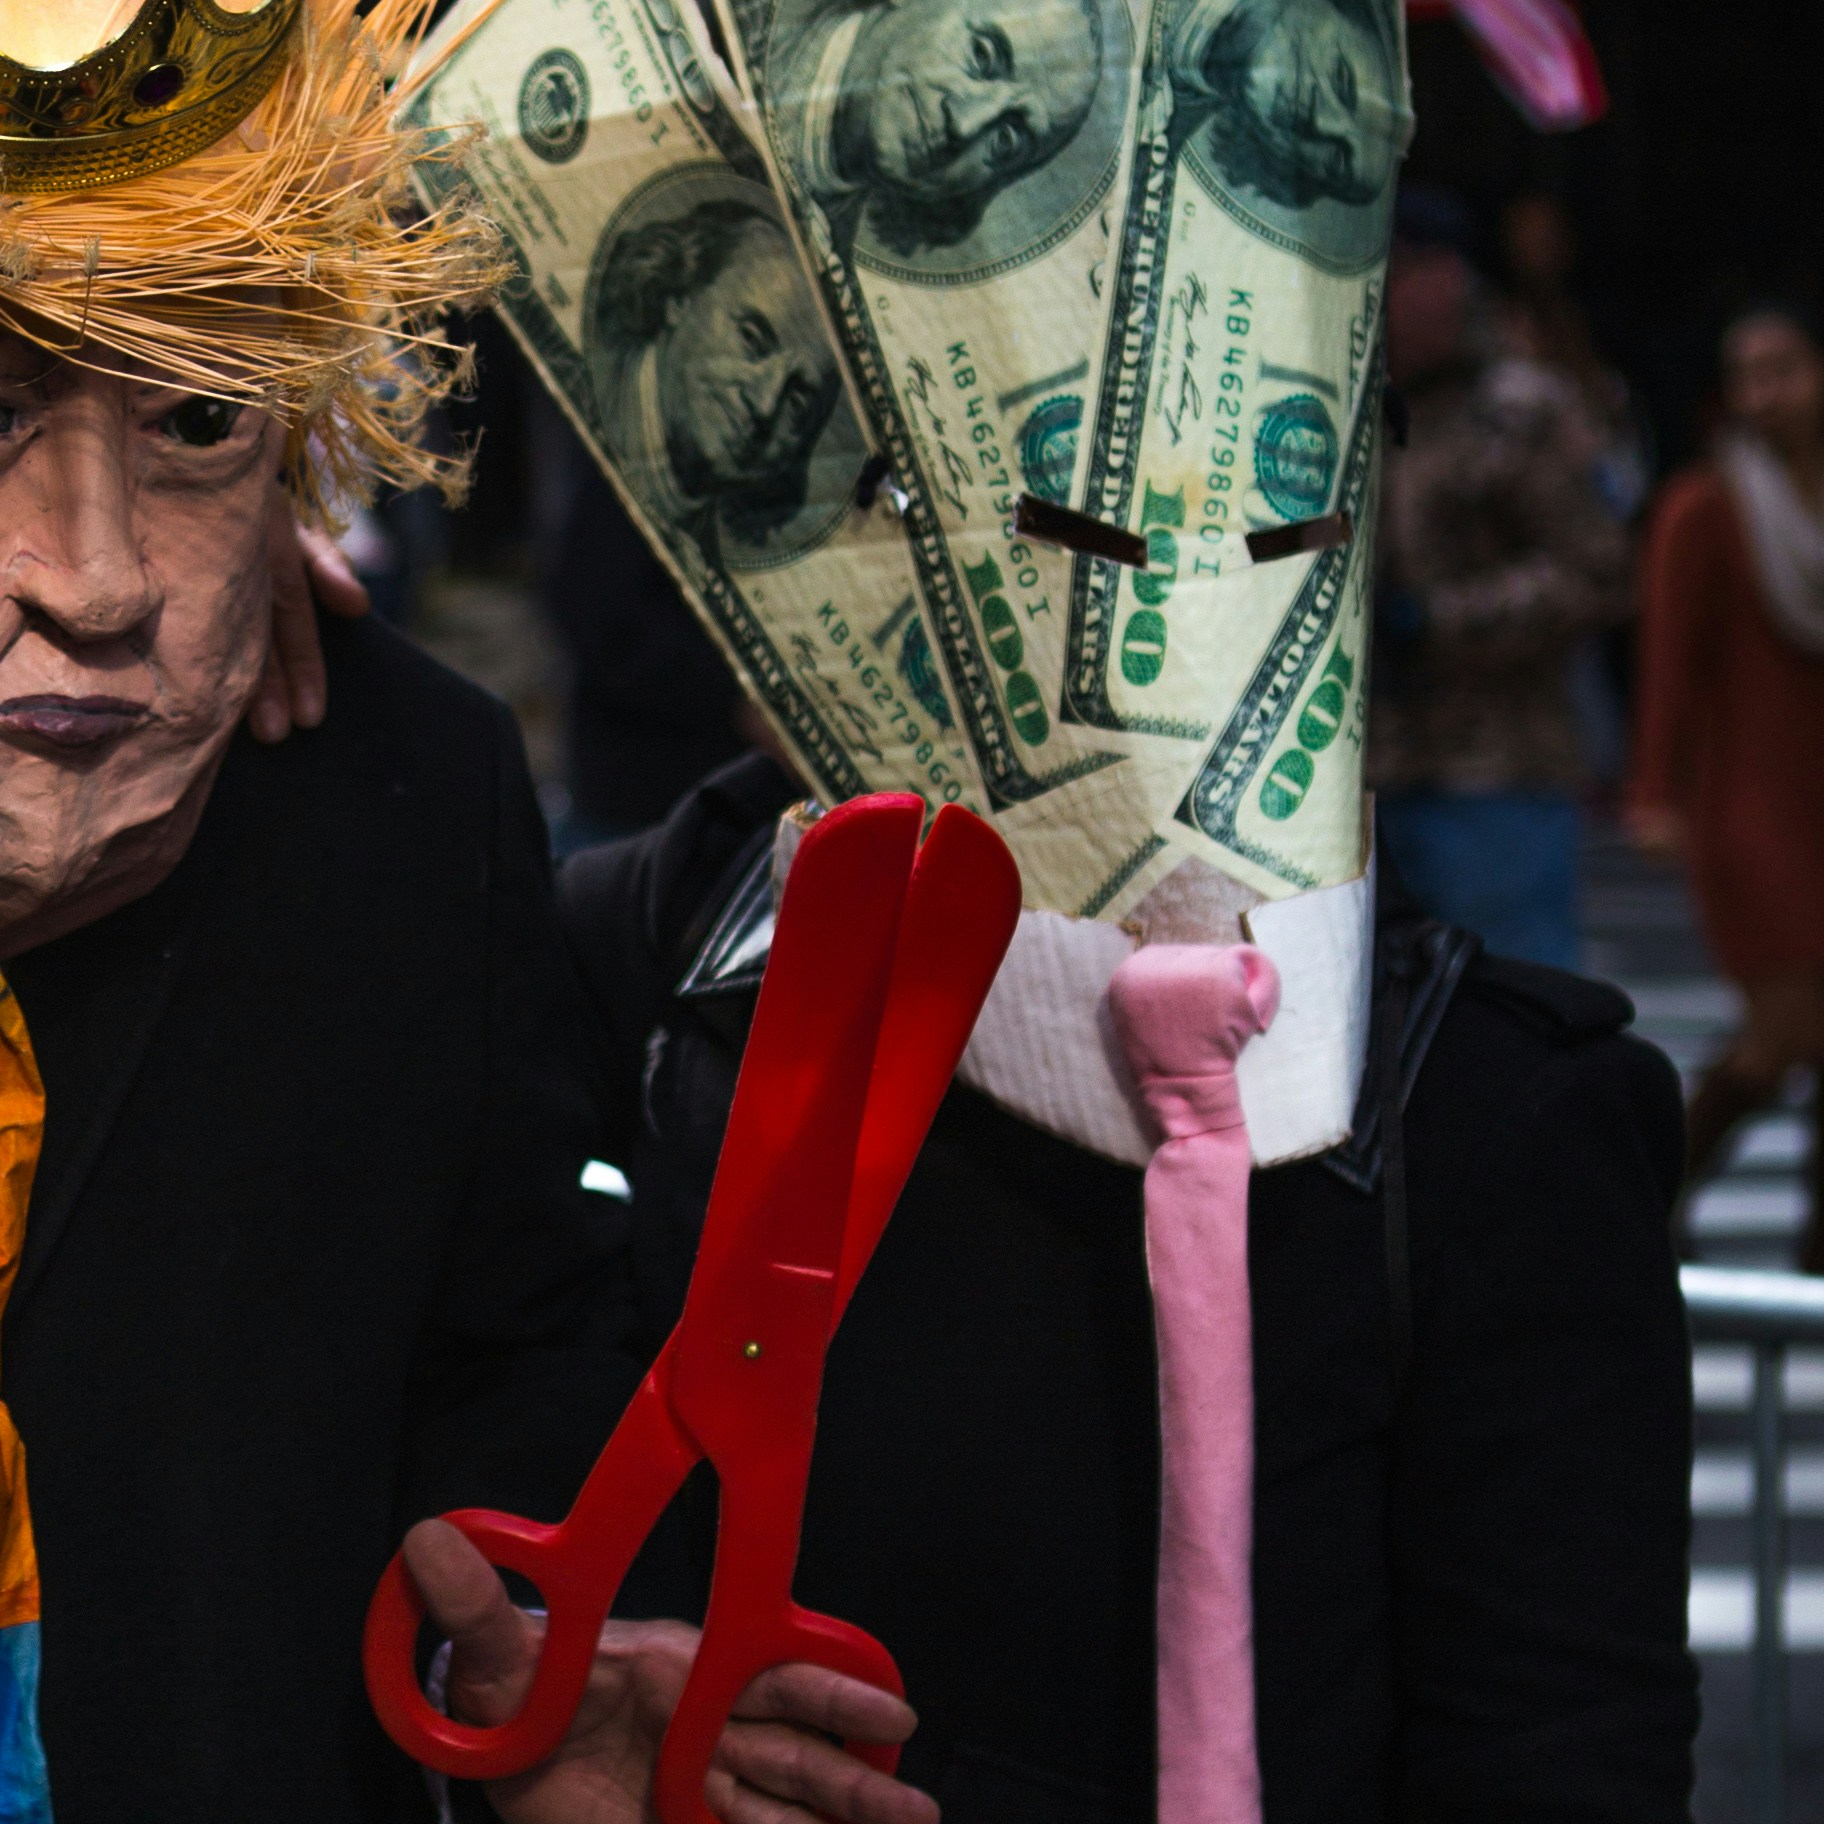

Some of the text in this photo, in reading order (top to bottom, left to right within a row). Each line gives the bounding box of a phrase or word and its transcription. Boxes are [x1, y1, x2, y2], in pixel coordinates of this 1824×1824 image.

[942, 339, 980, 392] KB
[1076, 132, 1170, 696] ONE HUNDRED DOLARS
[1222, 288, 1254, 339] KB
[821, 250, 873, 346] ONE
[856, 345, 946, 569] HUNDRED
[928, 564, 1015, 782] DOLLARS
[1197, 345, 1249, 546] 46279860
[958, 546, 1056, 752] 100
[1117, 477, 1190, 690] 100
[814, 599, 854, 648] KB
[842, 645, 968, 806] 46279860
[1204, 611, 1323, 811] DOLLARS
[1248, 634, 1373, 831] 100
